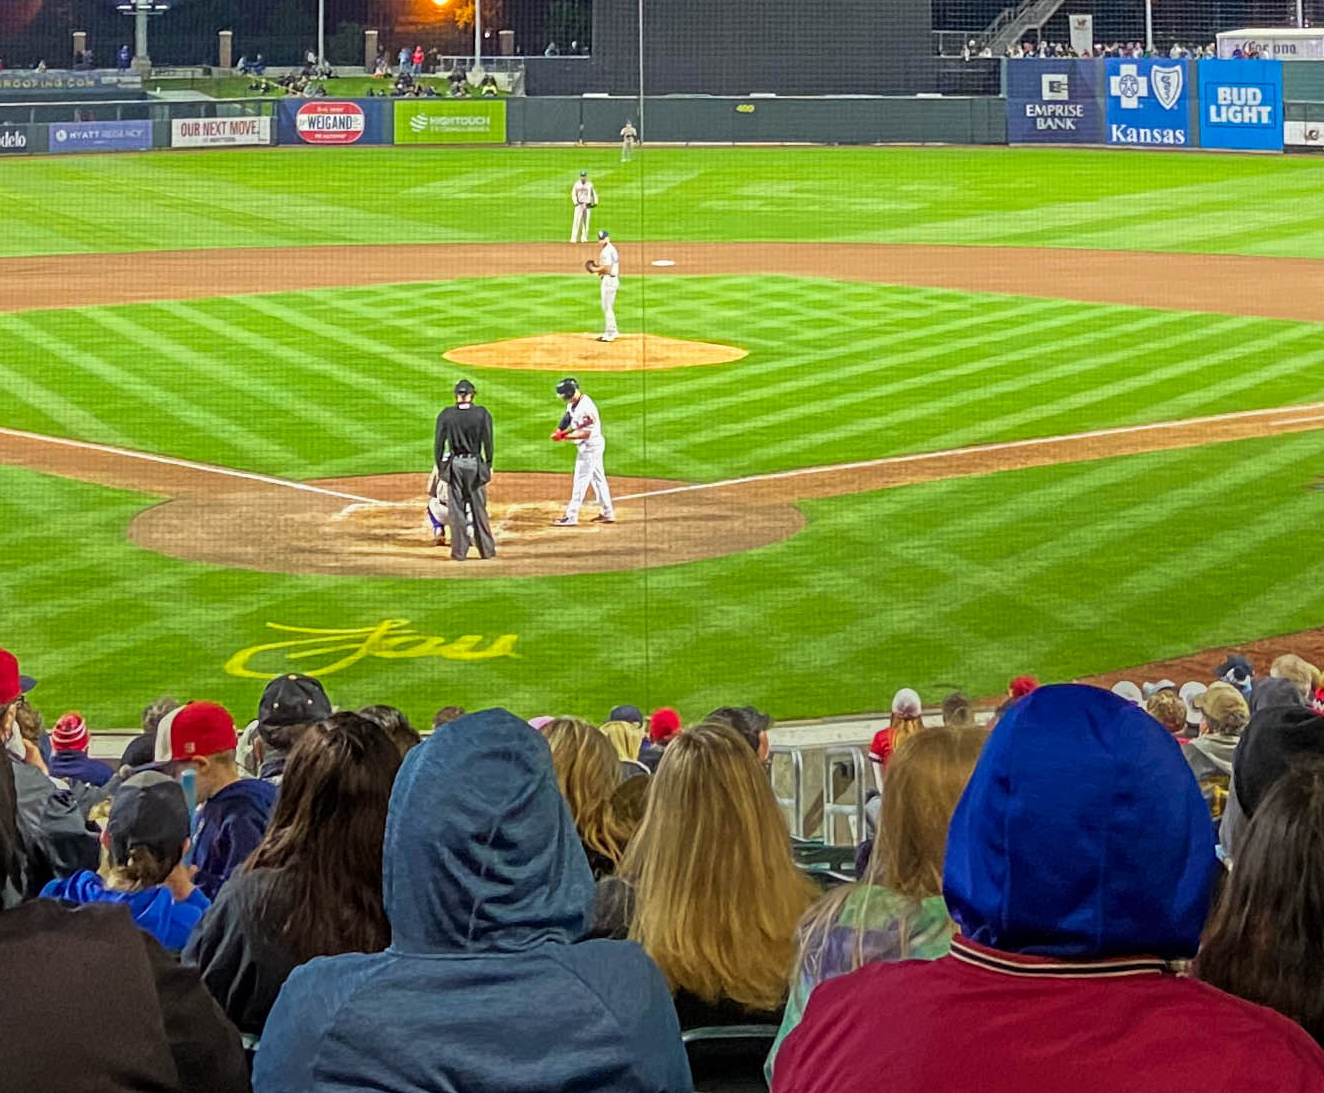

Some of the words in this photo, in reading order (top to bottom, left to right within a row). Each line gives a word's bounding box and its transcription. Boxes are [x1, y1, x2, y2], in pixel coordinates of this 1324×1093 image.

[1217, 86, 1263, 106] BUD
[1025, 104, 1084, 118] EMPRISE
[1209, 105, 1273, 124] LIGHT
[180, 121, 200, 137] OUR
[203, 120, 228, 136] NEXT
[308, 115, 353, 130] WEIGAND
[1036, 117, 1076, 130] BANK
[69, 129, 100, 140] HYATT
[1110, 123, 1186, 145] Kansas
